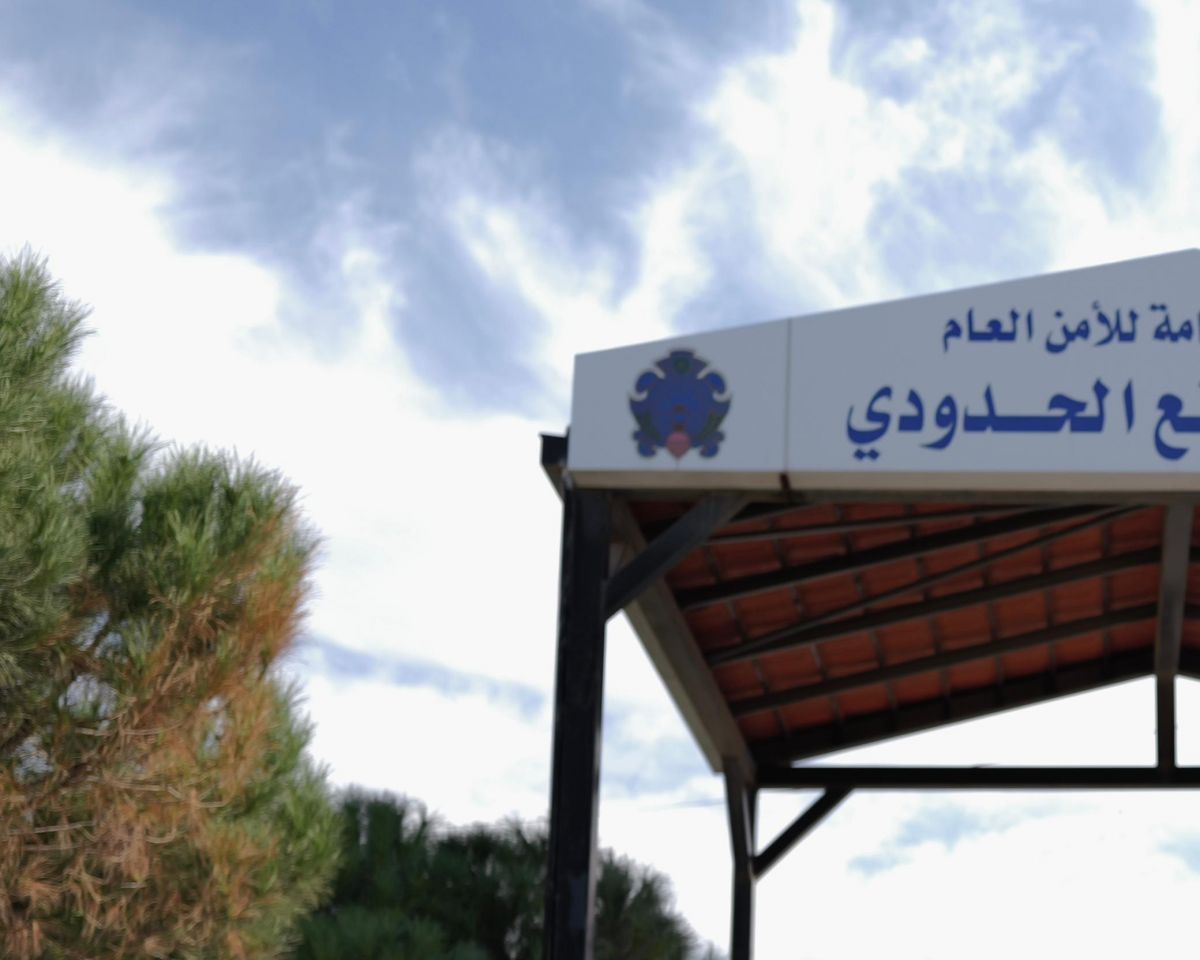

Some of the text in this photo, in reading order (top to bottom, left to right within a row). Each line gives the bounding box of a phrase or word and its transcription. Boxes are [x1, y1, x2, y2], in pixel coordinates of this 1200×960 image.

[942, 309, 1035, 352] العام
[1044, 301, 1139, 355] للأمن
[846, 379, 1136, 462] الحدودي
